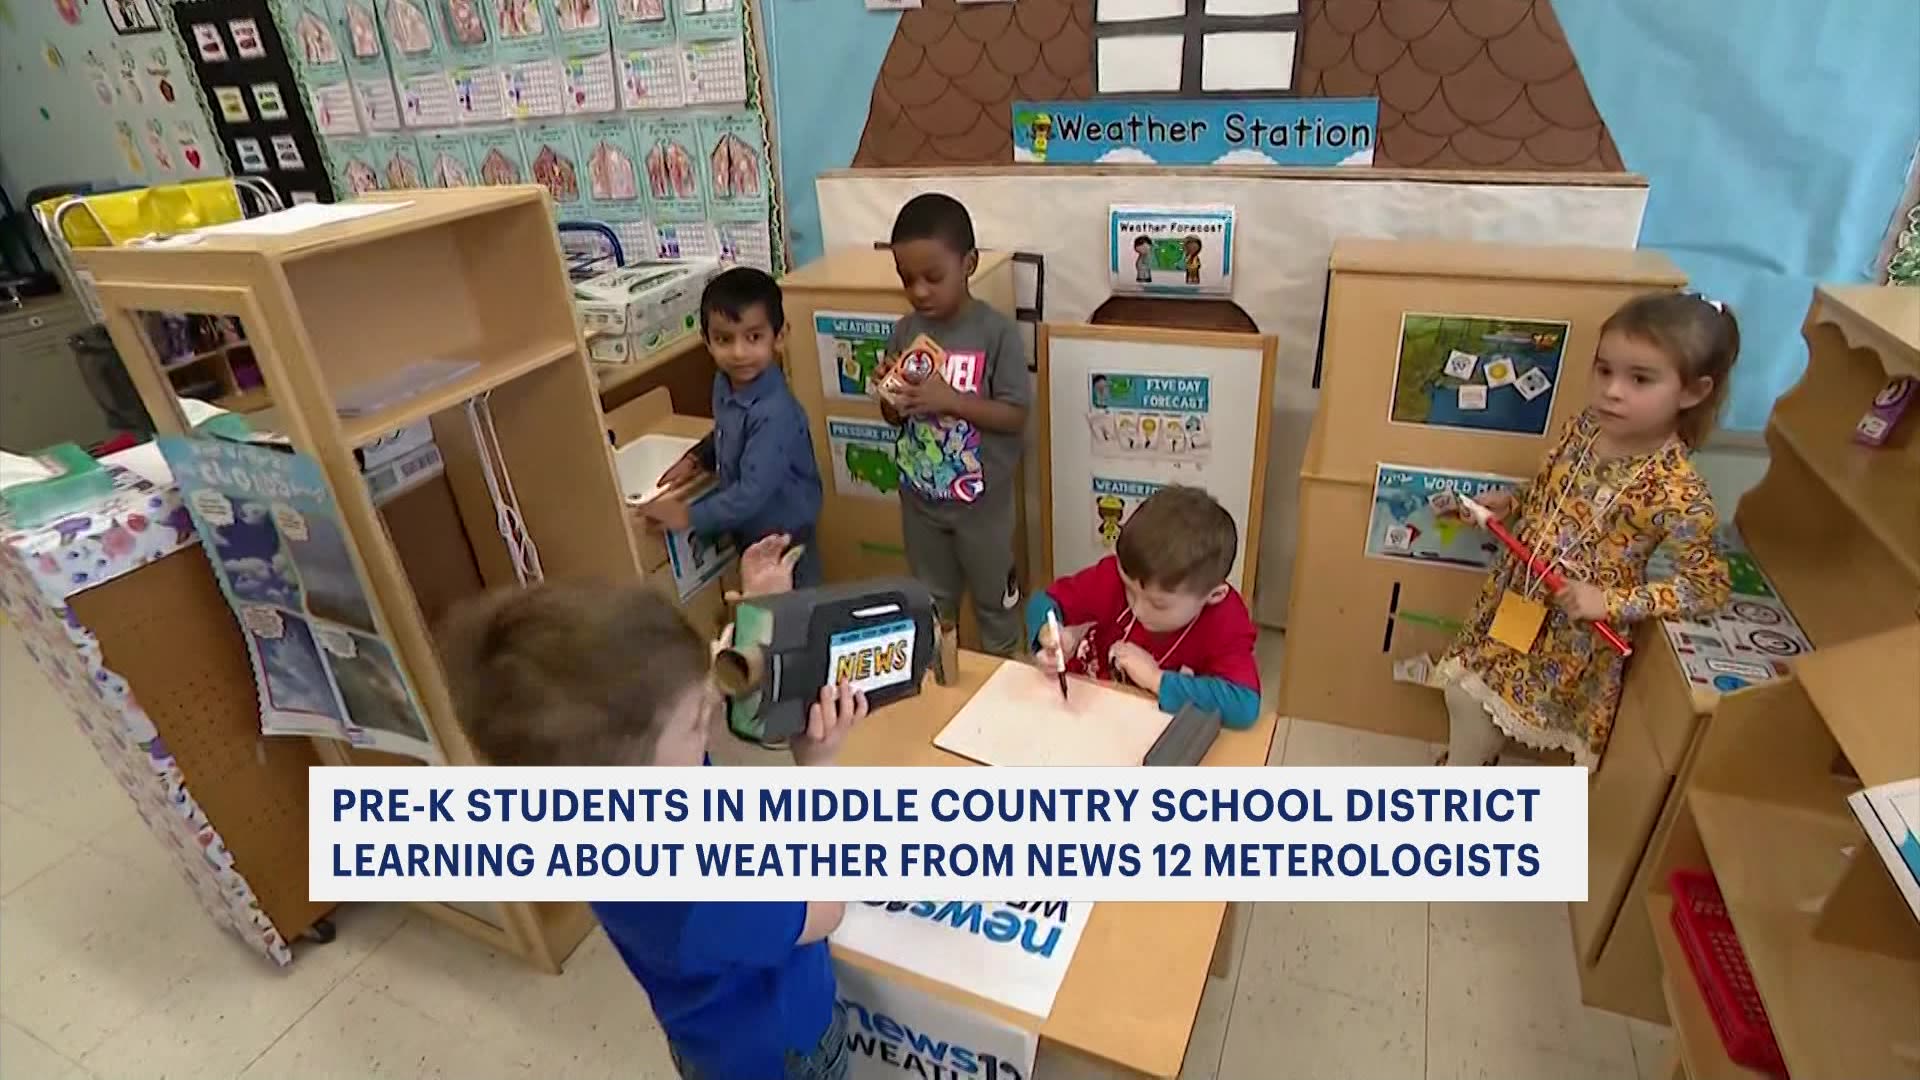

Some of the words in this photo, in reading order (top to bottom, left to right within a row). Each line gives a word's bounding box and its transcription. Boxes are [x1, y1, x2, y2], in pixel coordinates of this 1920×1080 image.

[1057, 111, 1208, 144] Weather
[1224, 112, 1371, 149] Station
[1120, 221, 1167, 233] Weather
[1170, 221, 1223, 234] Forecast
[942, 353, 977, 393] VEL
[1146, 378, 1176, 392] FIVE
[1177, 380, 1201, 393] DAY
[1143, 395, 1204, 409] FORECAST
[1423, 475, 1472, 493] WORLD
[836, 640, 908, 687] NEWS
